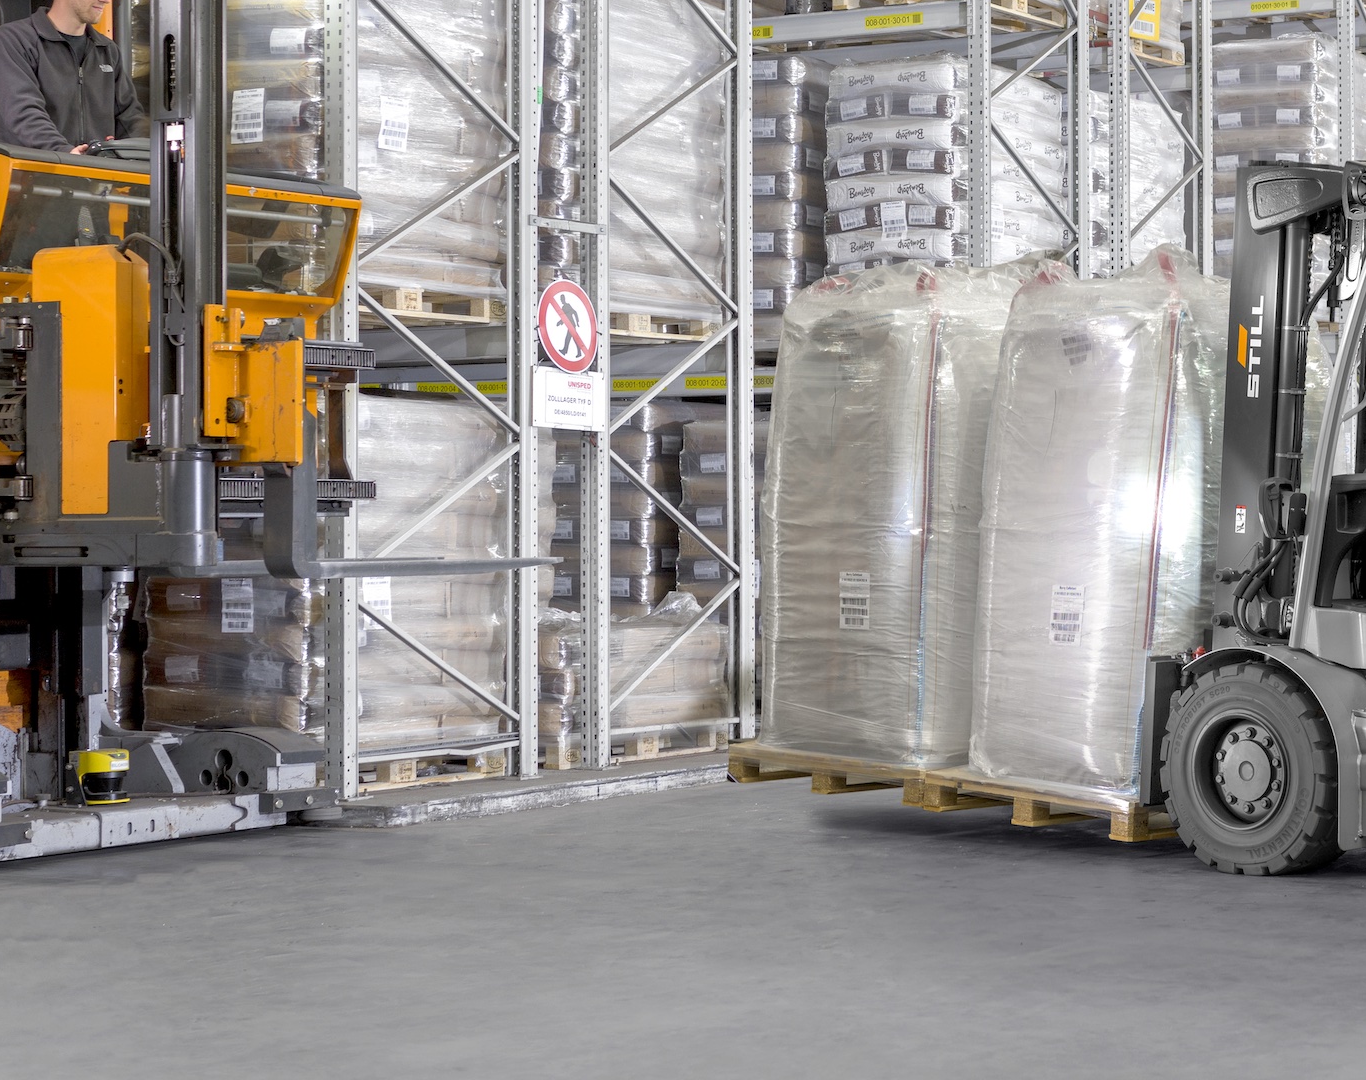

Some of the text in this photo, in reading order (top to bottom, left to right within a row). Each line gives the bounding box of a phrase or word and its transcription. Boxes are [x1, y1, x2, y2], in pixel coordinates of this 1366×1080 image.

[865, 15, 910, 27] 008-001-30-01
[1247, 295, 1265, 398] STILL
[1209, 685, 1231, 698] SC20
[1245, 787, 1310, 859] CONTINENTAL
